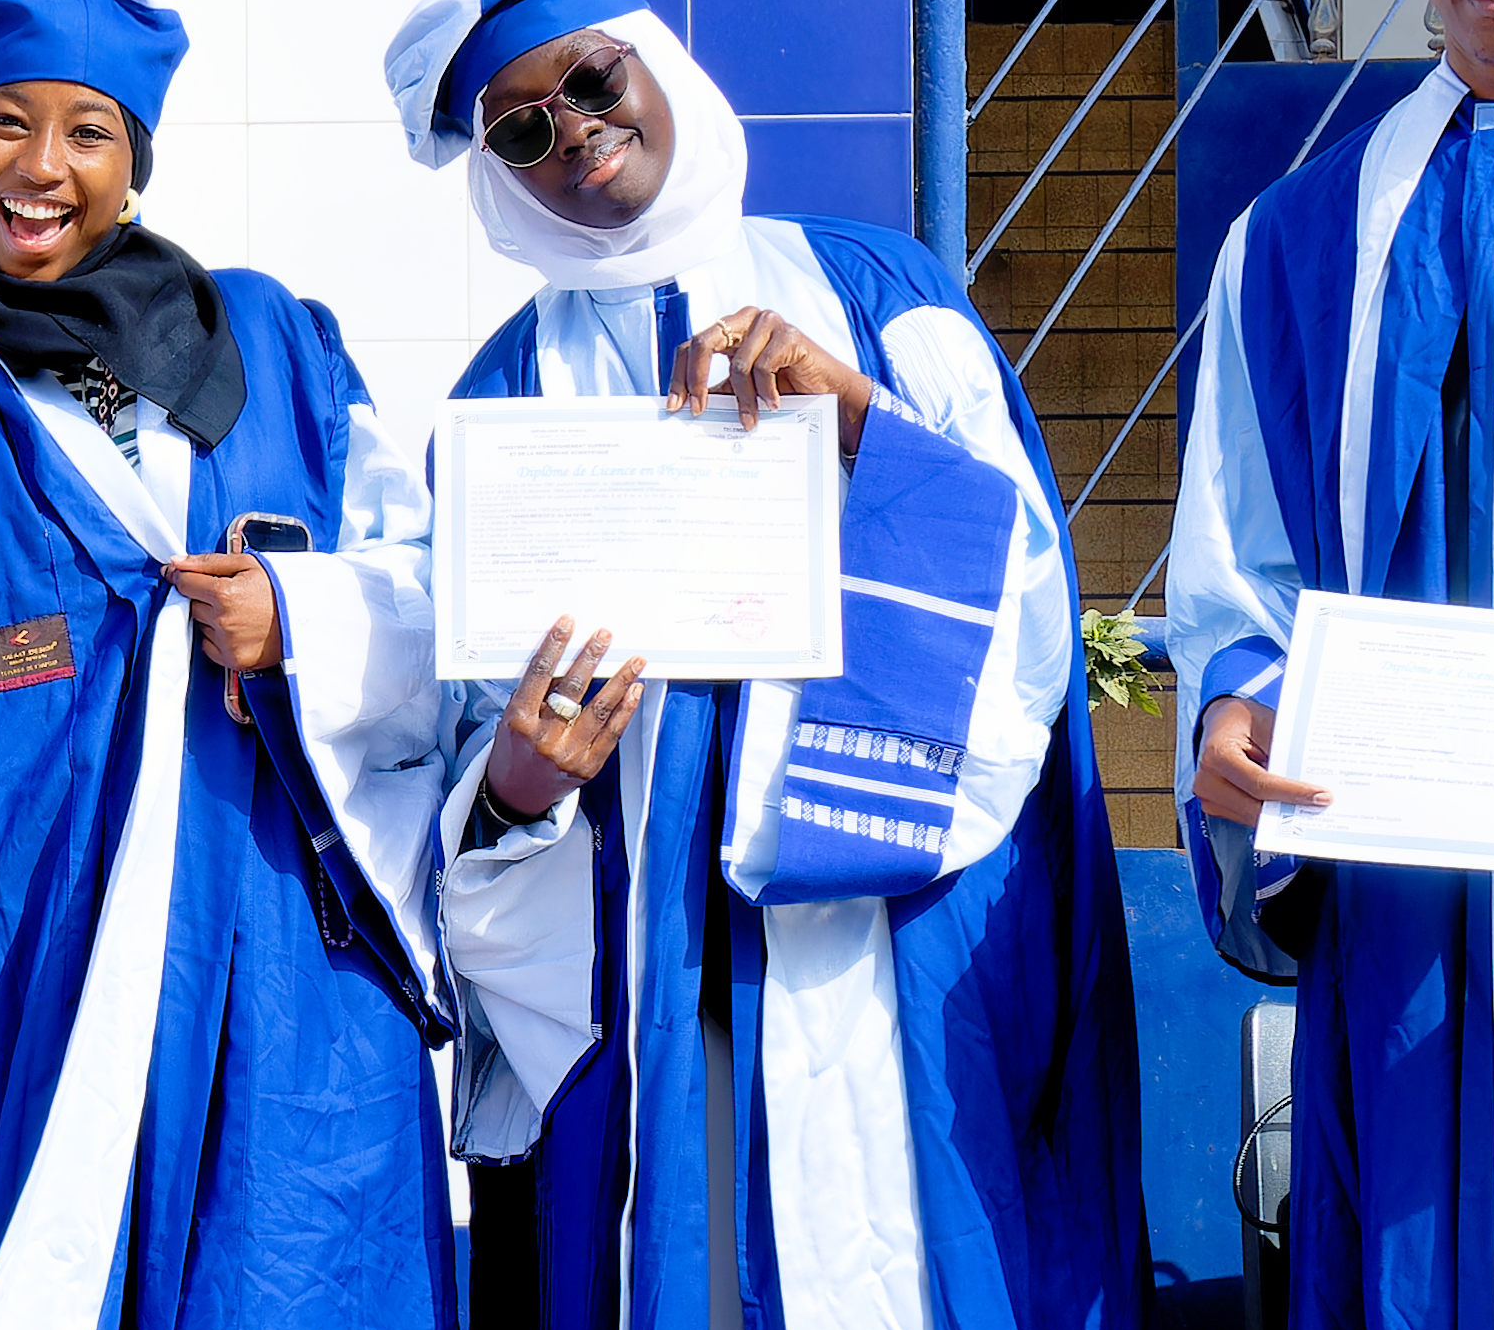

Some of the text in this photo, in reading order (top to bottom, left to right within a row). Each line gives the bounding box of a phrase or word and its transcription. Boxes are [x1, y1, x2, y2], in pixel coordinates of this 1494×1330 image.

[517, 464, 569, 481] Diplôme
[572, 464, 587, 477] de
[590, 465, 637, 477] Licence
[640, 467, 654, 476] en
